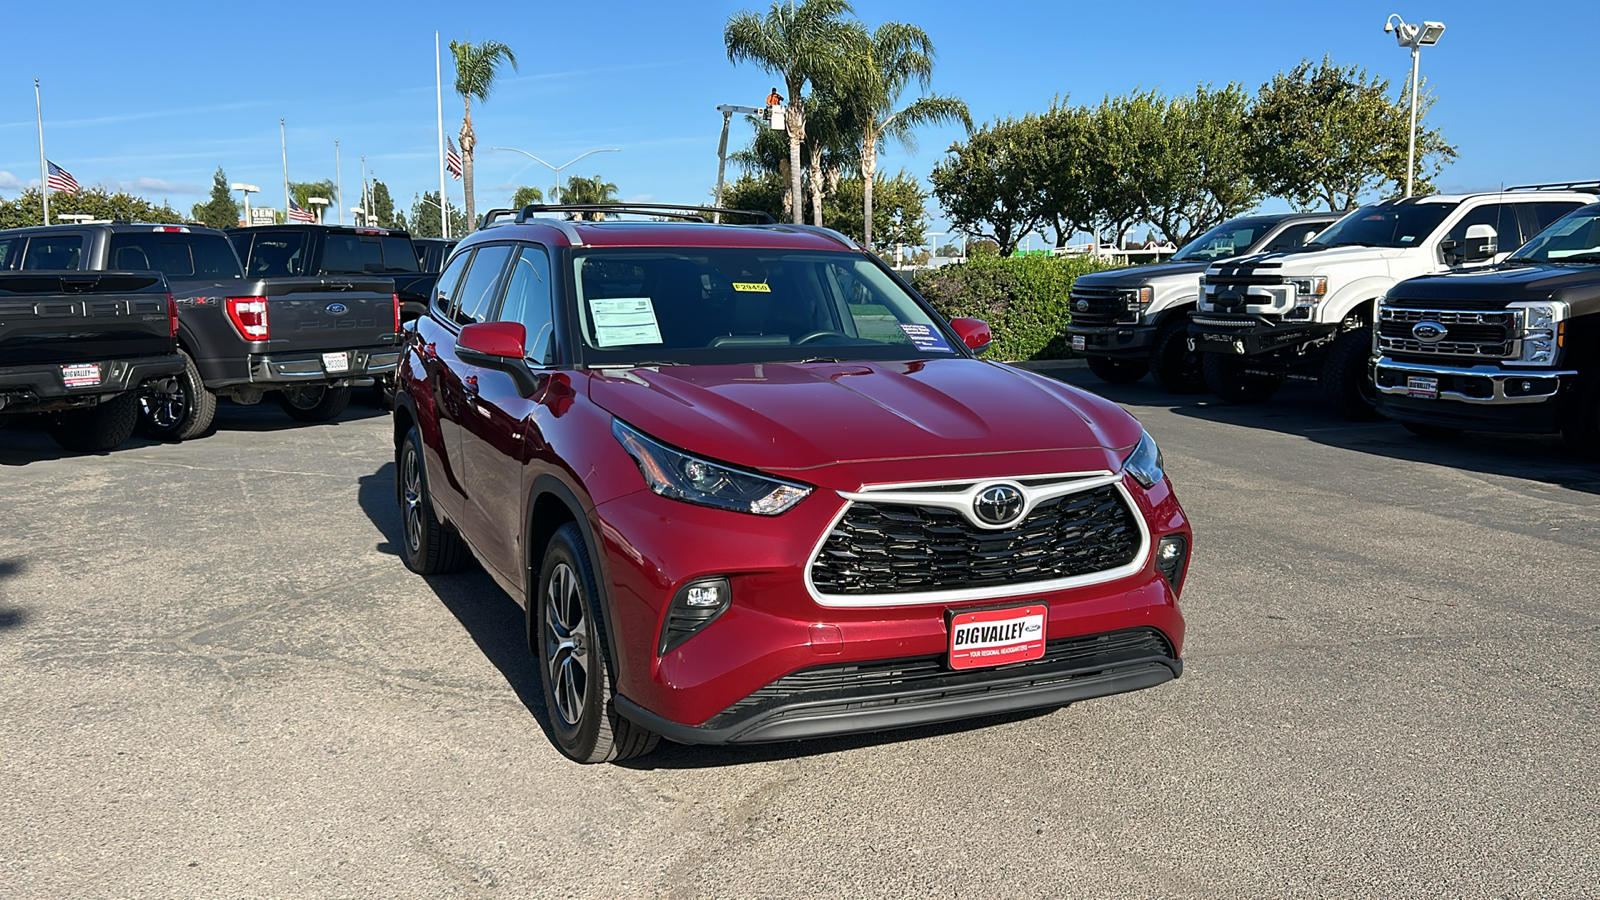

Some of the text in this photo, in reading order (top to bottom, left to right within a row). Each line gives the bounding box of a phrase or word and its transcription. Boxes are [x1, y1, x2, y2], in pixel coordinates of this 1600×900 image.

[252, 209, 274, 218] OEM
[981, 649, 1001, 657] REGIONAL
[1001, 645, 1028, 655] HEADQUARTERS
